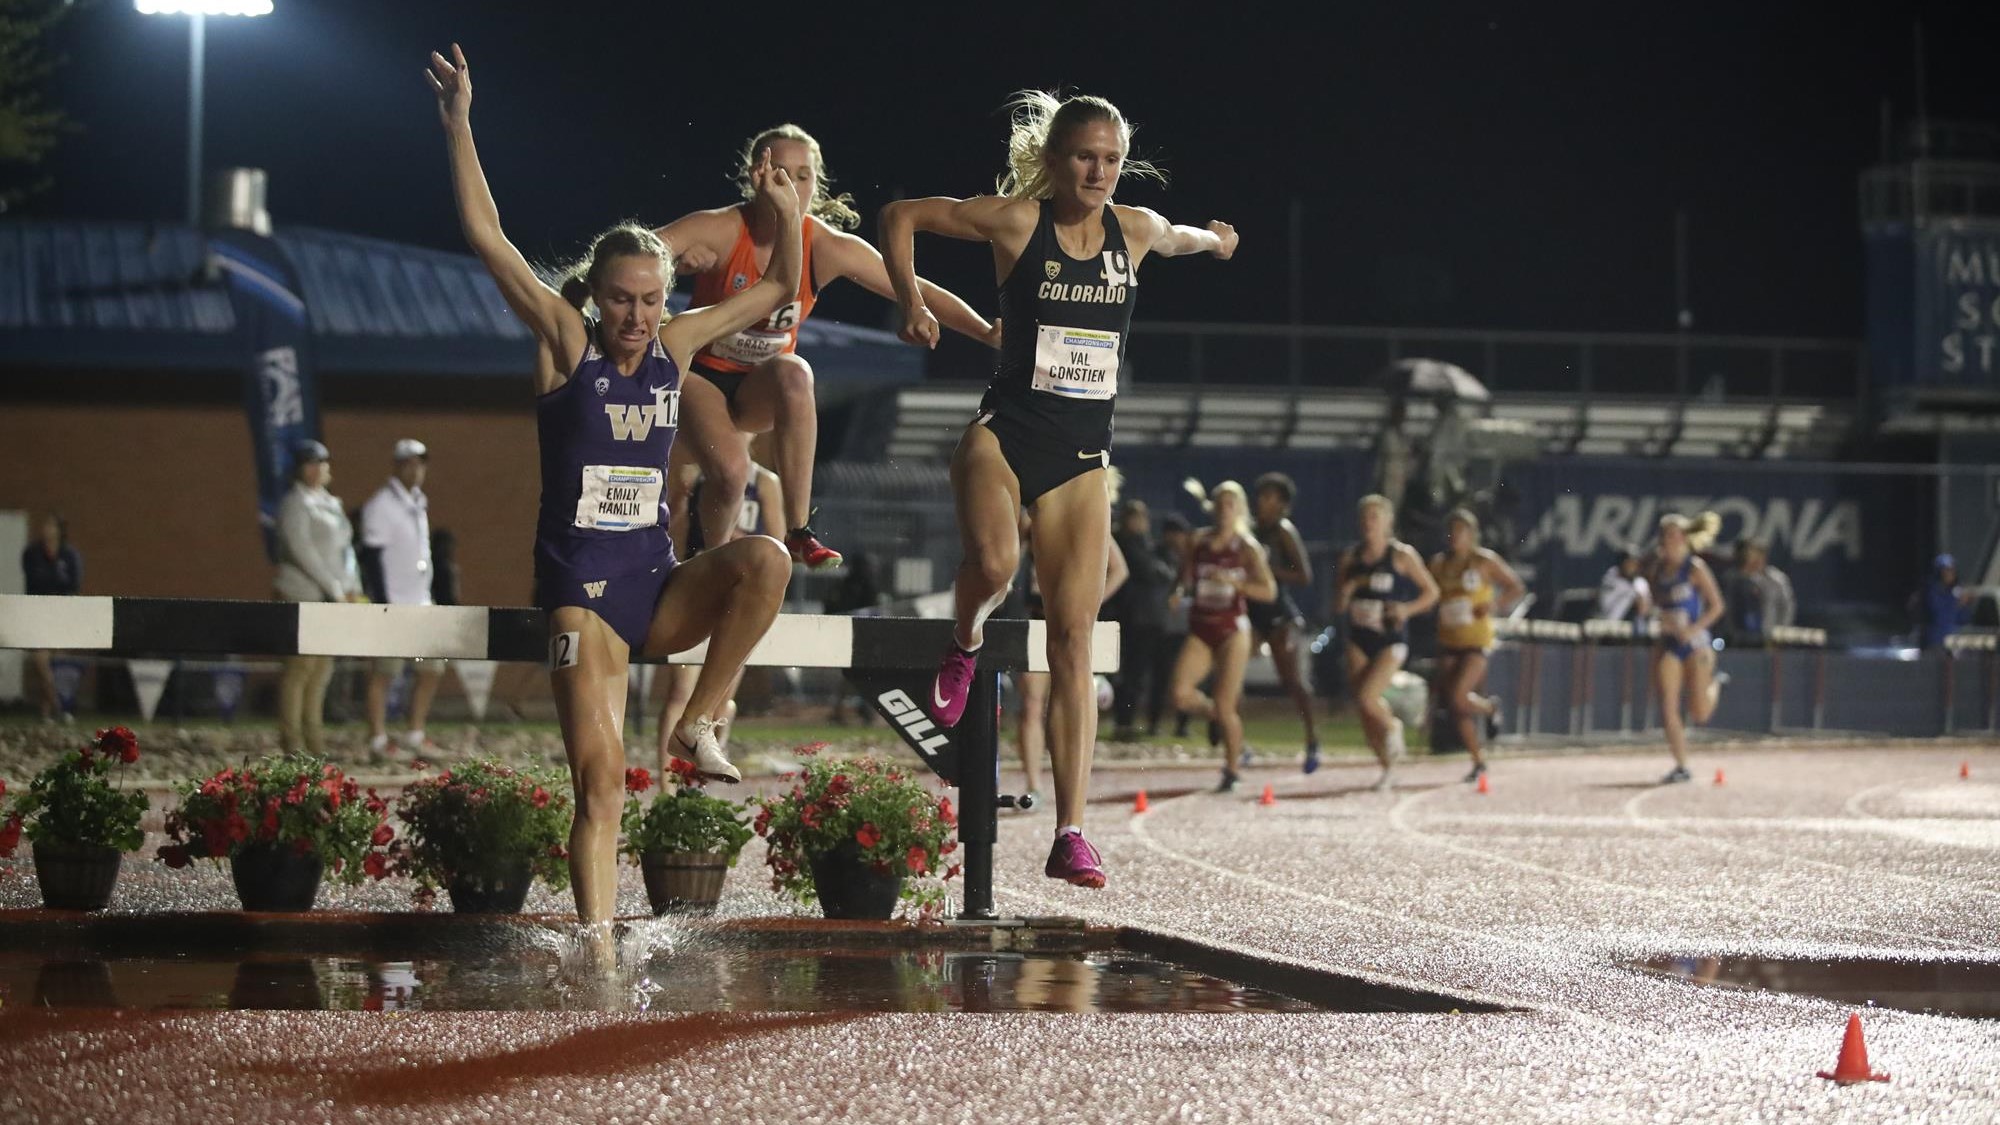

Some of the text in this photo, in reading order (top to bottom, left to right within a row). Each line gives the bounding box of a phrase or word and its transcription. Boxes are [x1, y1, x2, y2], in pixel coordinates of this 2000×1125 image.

[1038, 281, 1126, 304] COLORADO
[1071, 351, 1091, 366] VAL
[1049, 365, 1106, 383] CONSTIEN
[605, 404, 656, 441] W
[606, 488, 639, 500] EMILY
[598, 502, 640, 516] HAMLIN
[583, 580, 607, 599] W
[878, 688, 950, 756] GILL
